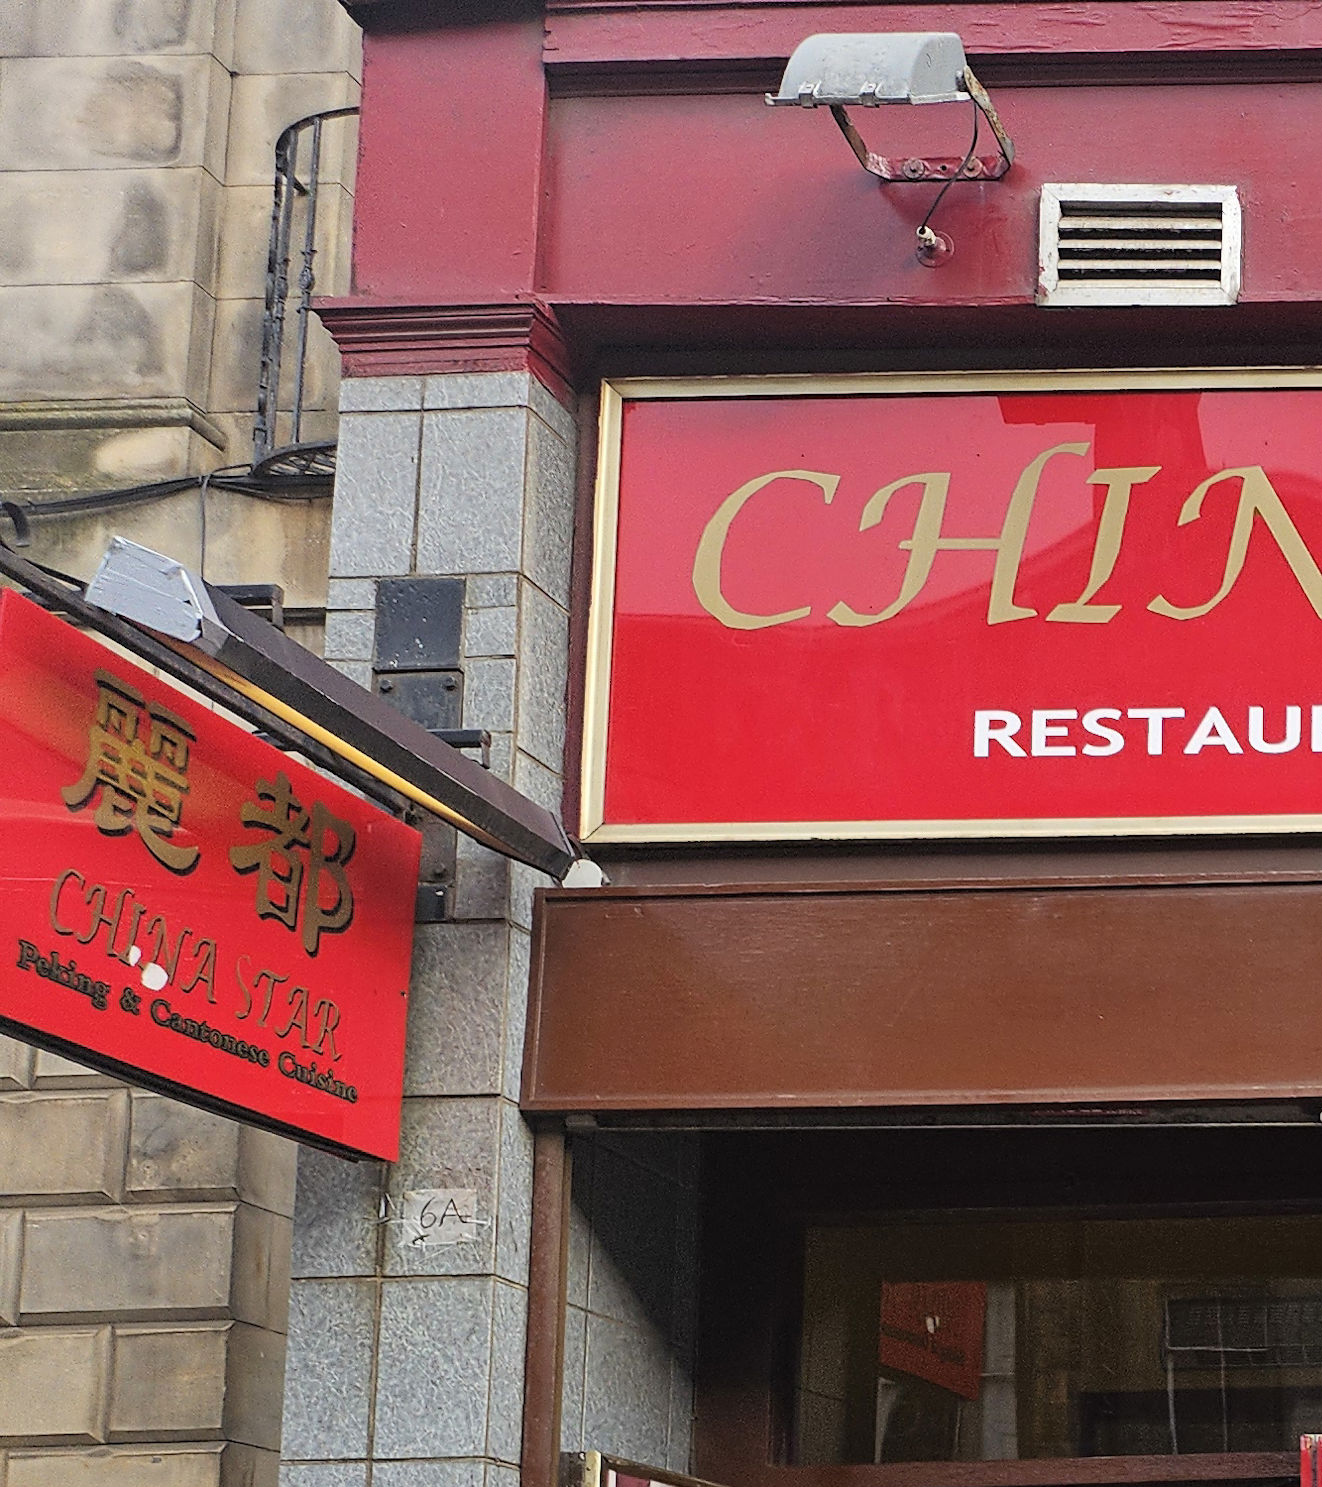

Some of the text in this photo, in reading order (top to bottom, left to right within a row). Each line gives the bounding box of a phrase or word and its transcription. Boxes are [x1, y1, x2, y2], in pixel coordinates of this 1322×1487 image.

[61, 667, 358, 958] 麗都
[16, 939, 359, 1104] Peking & Cantonese Cuisine
[50, 868, 343, 1061] CHINA STAR
[420, 1196, 473, 1229] 6A
